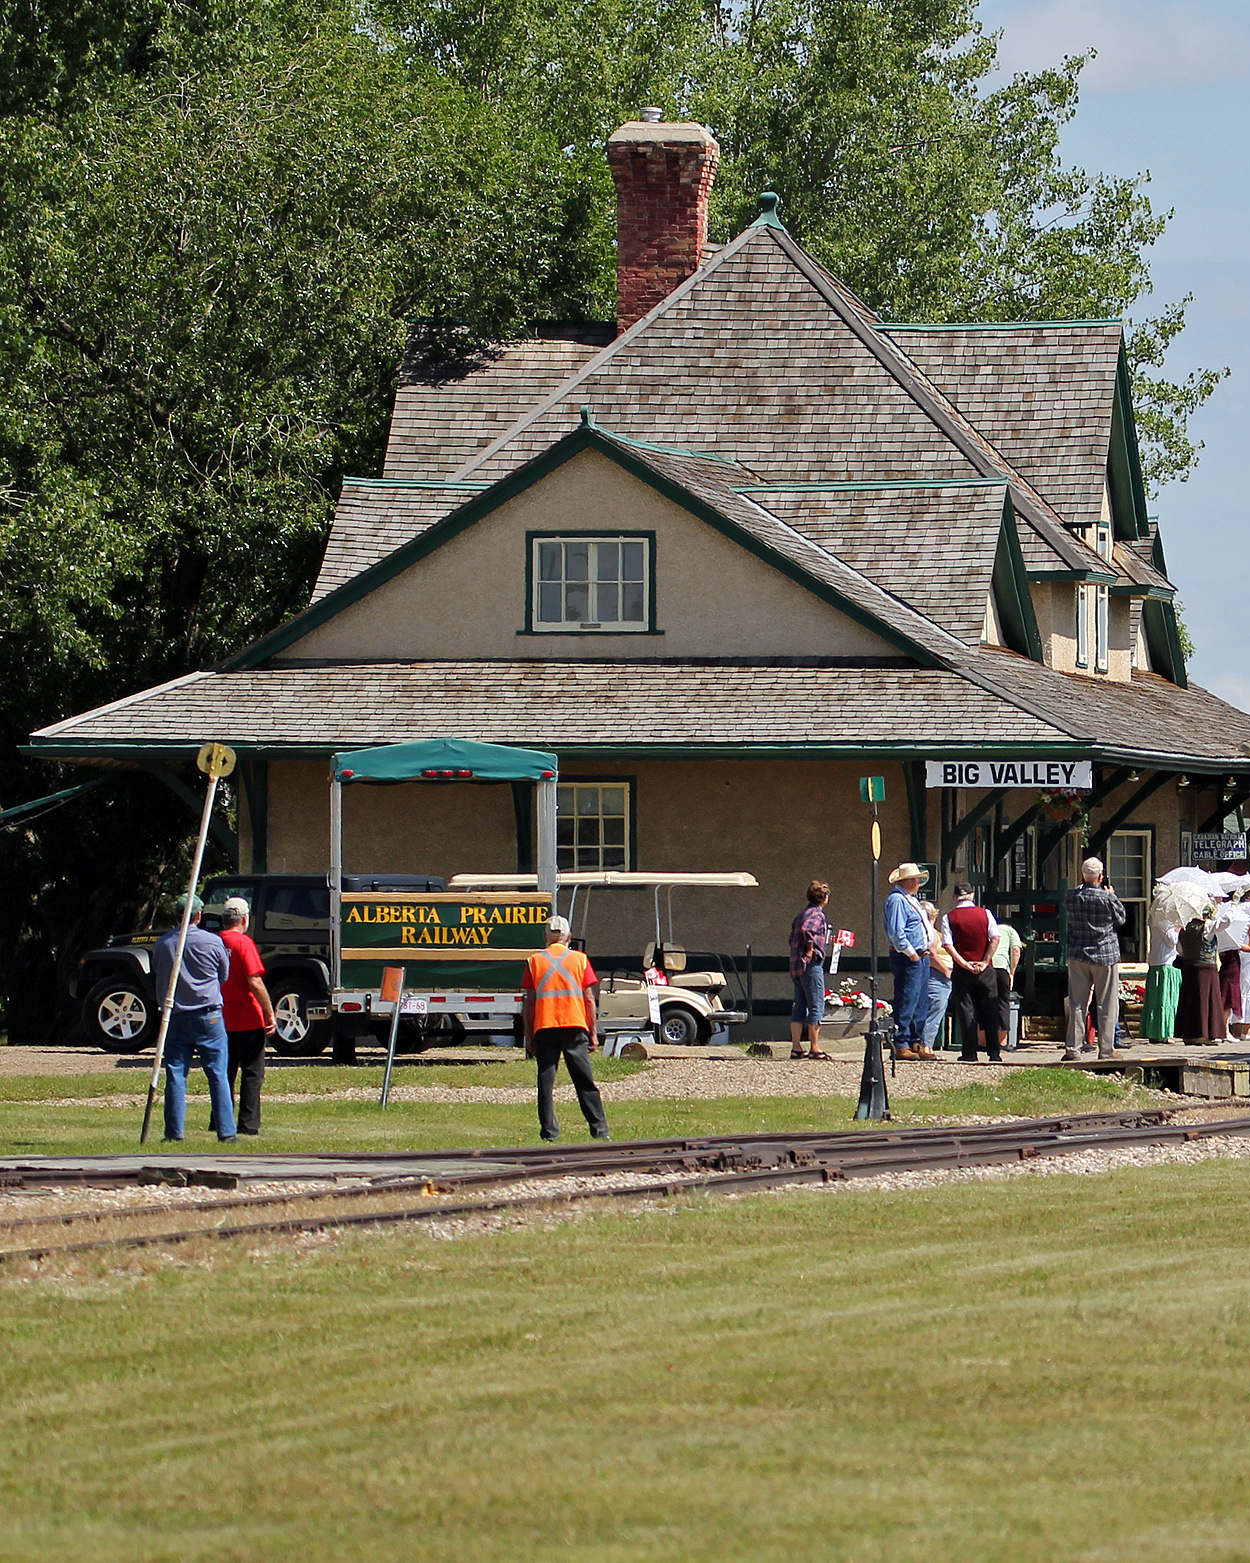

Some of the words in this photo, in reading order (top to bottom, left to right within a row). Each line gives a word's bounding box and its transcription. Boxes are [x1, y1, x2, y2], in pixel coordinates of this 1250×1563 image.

[943, 763, 979, 784] BIG
[990, 763, 1076, 784] VALLEY
[1193, 840, 1245, 849] TELEGRAPH
[1193, 850, 1218, 859] CABLE
[1219, 850, 1245, 858] OFFICE
[346, 905, 441, 923] ALBERTA
[459, 906, 550, 924] PRAIRIE
[401, 926, 494, 945] RAILWAY
